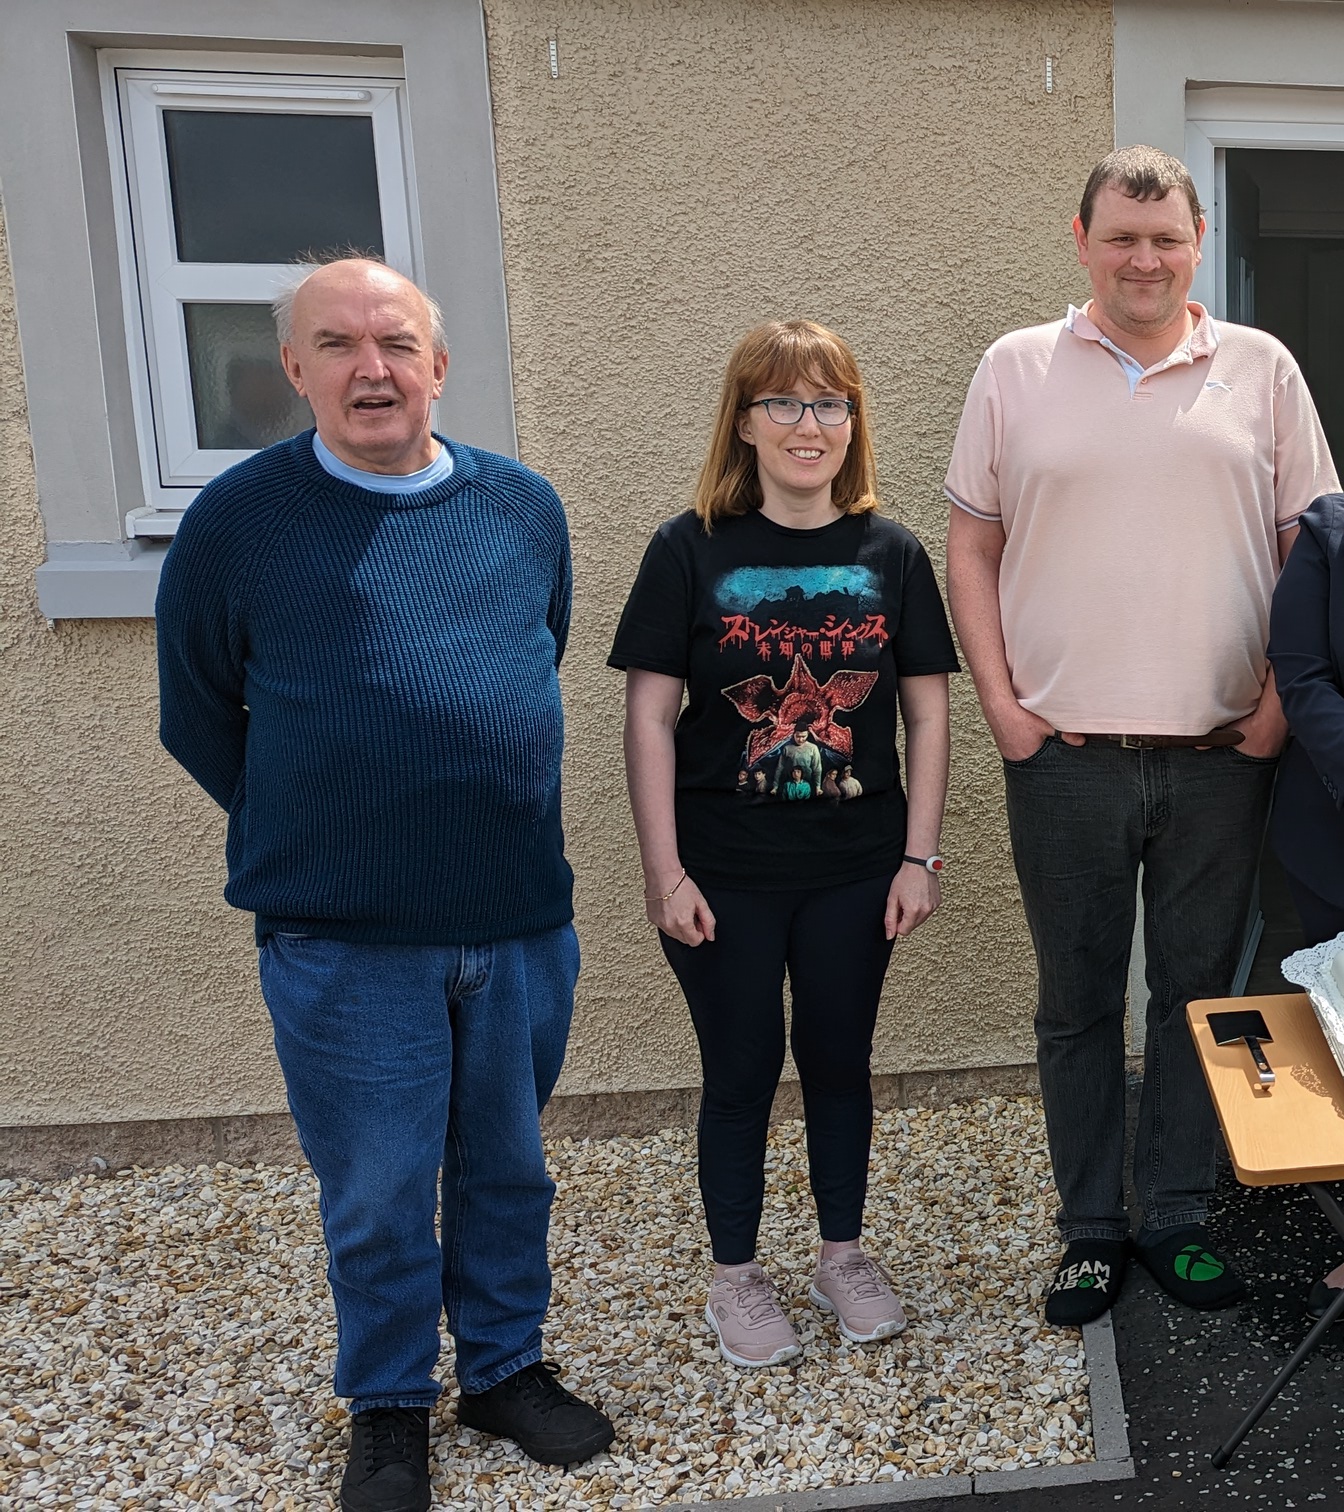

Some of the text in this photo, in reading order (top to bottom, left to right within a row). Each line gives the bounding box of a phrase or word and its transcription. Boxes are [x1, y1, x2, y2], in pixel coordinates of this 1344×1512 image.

[756, 640, 856, 660] 未知の世界
[1059, 1260, 1110, 1283] TEAM
[1050, 1274, 1110, 1294] XBOX
